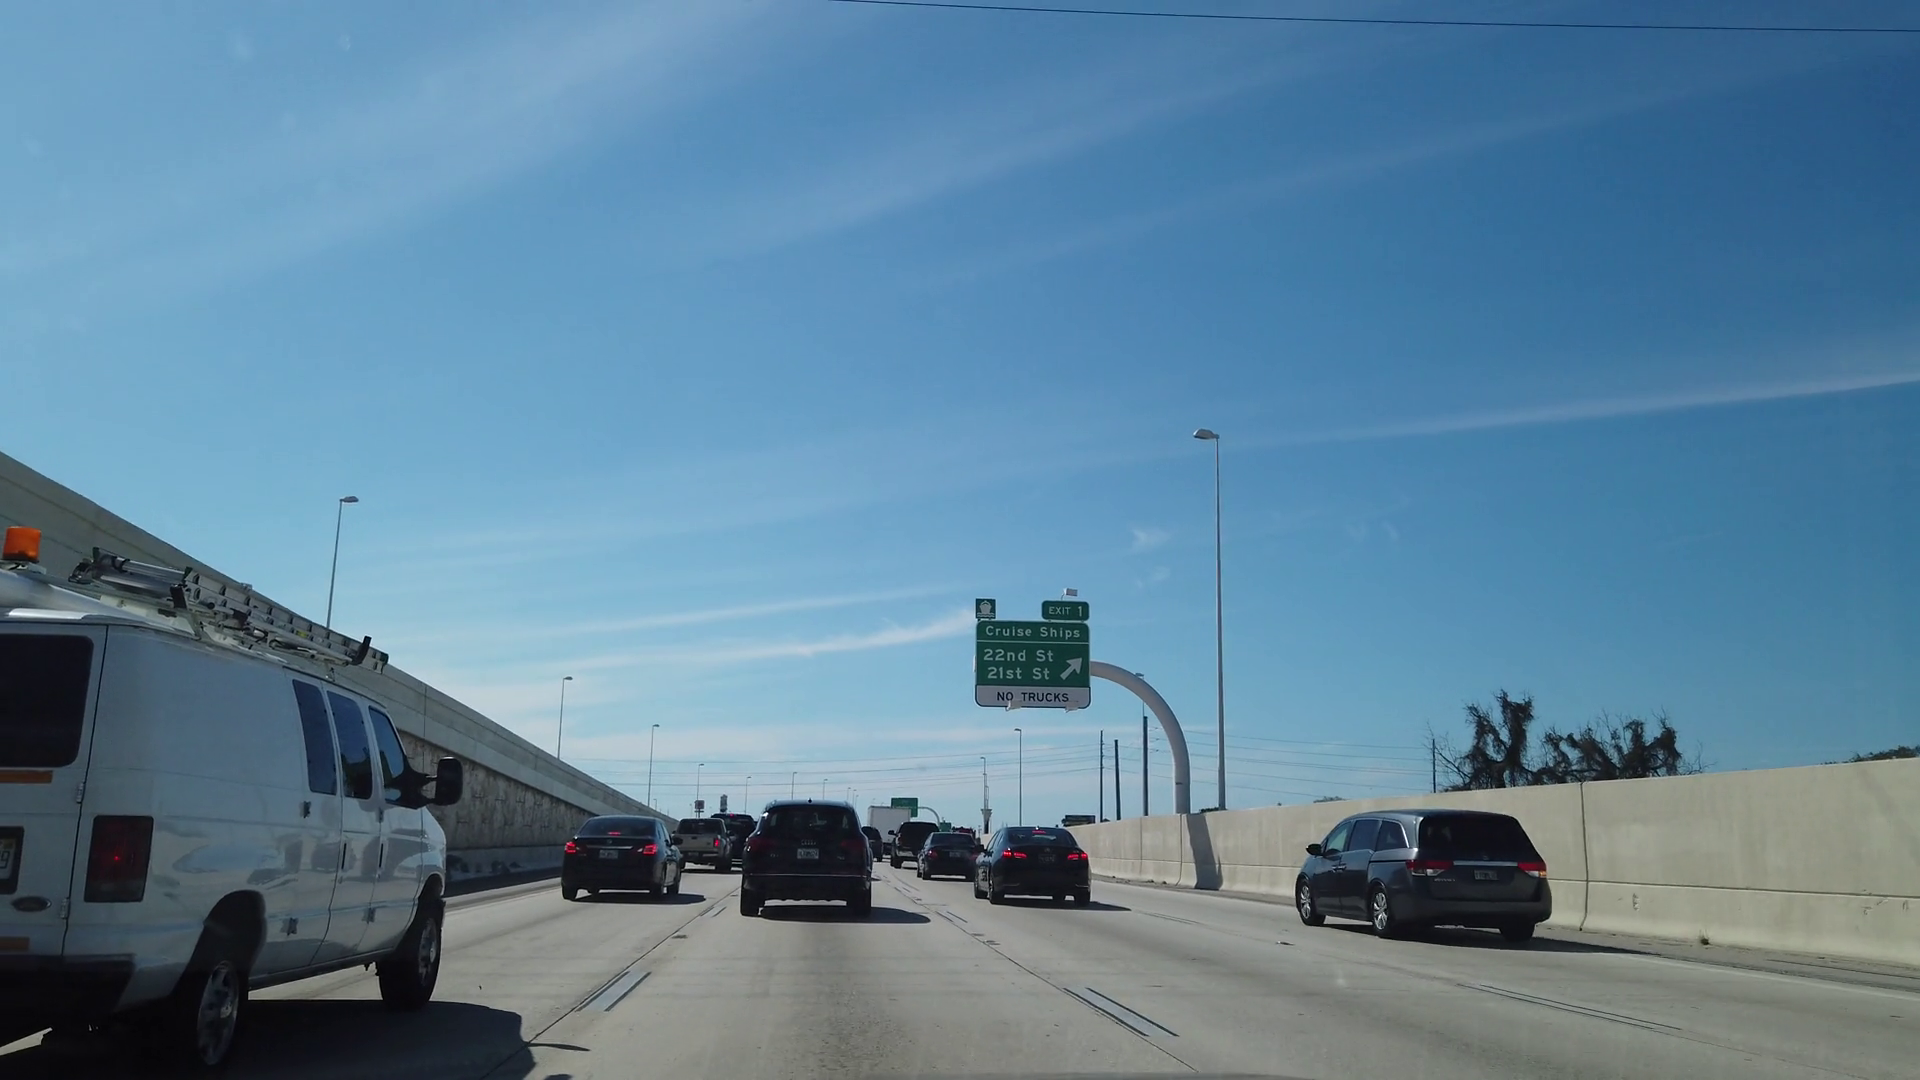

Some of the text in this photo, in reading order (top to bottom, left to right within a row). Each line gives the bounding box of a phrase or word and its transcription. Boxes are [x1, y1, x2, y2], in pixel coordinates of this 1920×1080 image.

[1048, 606, 1083, 617] EXIT 1
[985, 626, 1080, 639] Cruise Ships
[983, 649, 1054, 662] 22nd St
[987, 667, 1050, 680] 21st St
[997, 692, 1069, 702] NO TRUCKS
